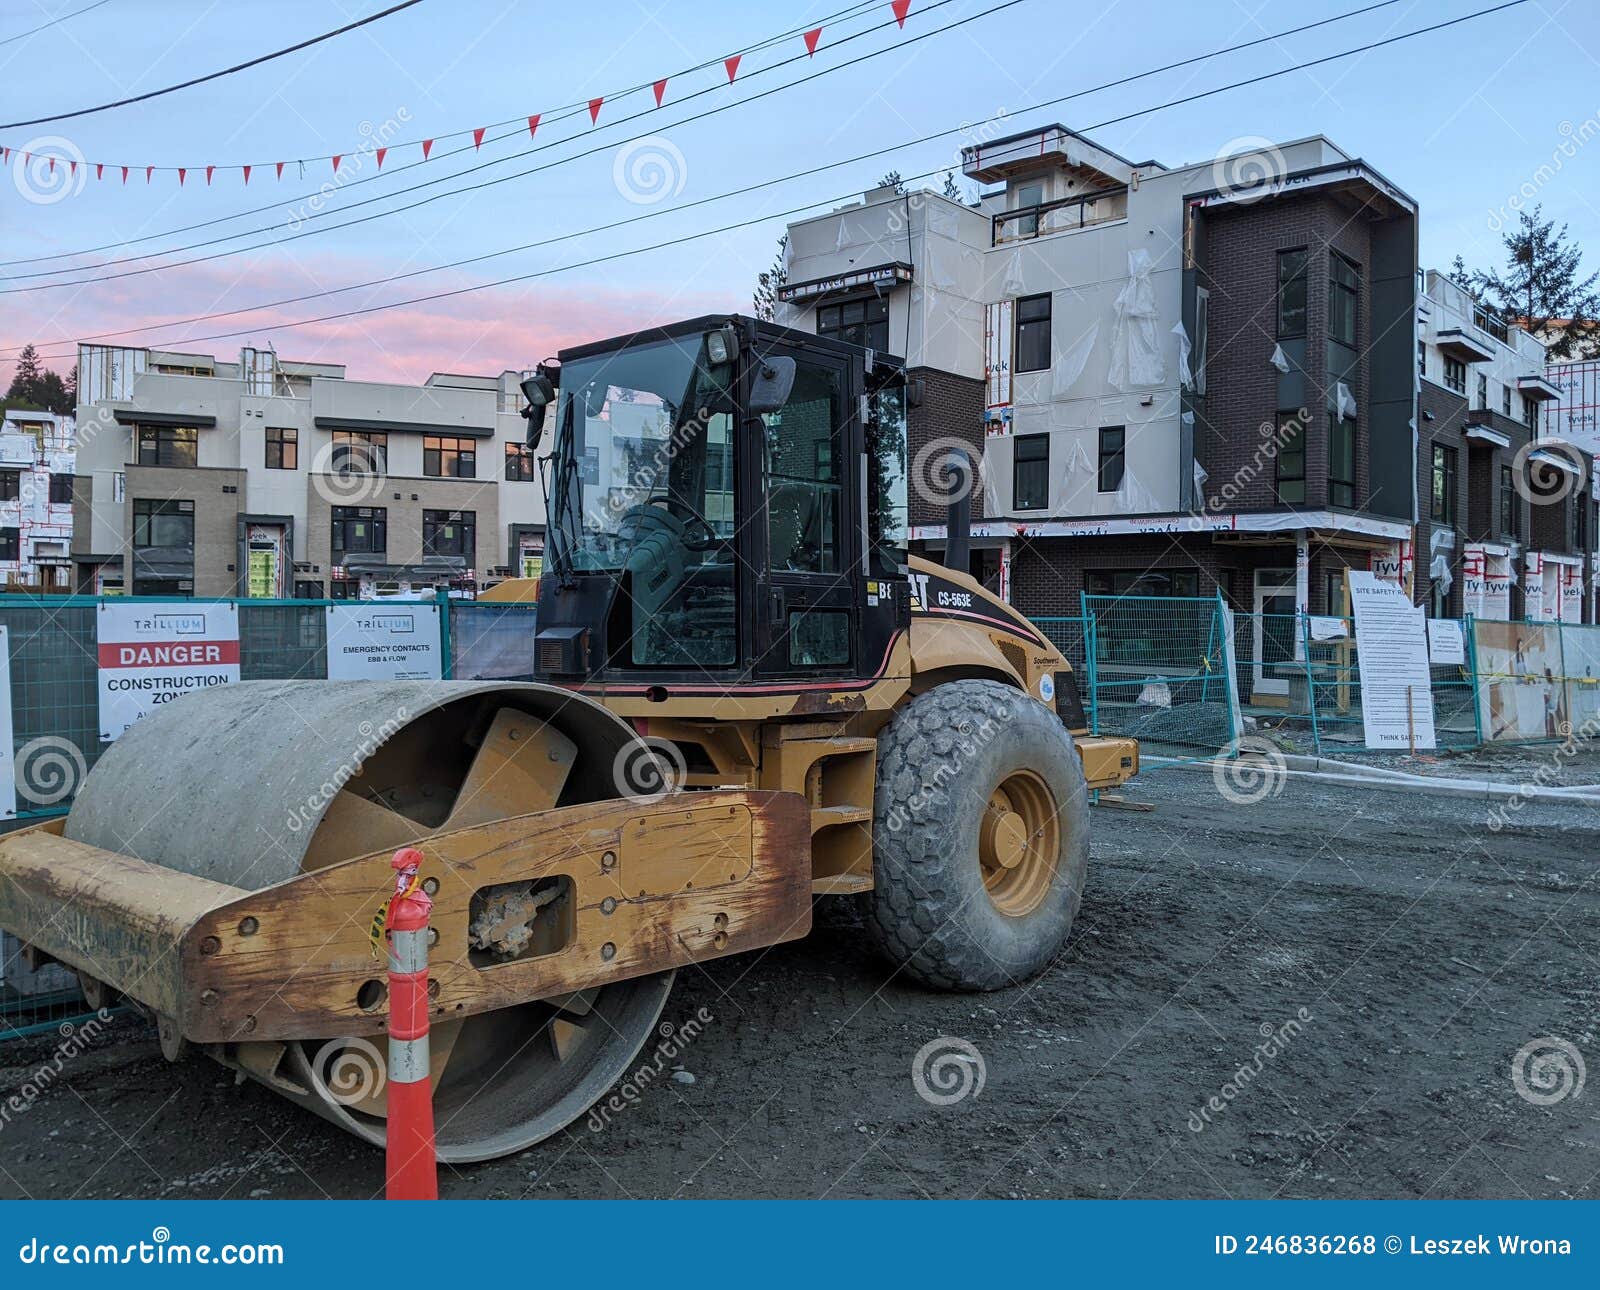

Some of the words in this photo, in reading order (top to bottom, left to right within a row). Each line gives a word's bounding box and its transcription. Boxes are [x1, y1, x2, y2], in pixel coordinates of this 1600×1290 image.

[1371, 588, 1396, 596] SAFETY
[938, 591, 971, 608] CS-563E
[134, 619, 201, 630] TRILLIUM
[357, 620, 410, 629] TRILLIUM
[343, 644, 391, 654] EMERGENCY
[392, 644, 430, 653] CONTACTS
[119, 645, 221, 665] DANGER
[107, 674, 229, 691] CONSTRUCTION
